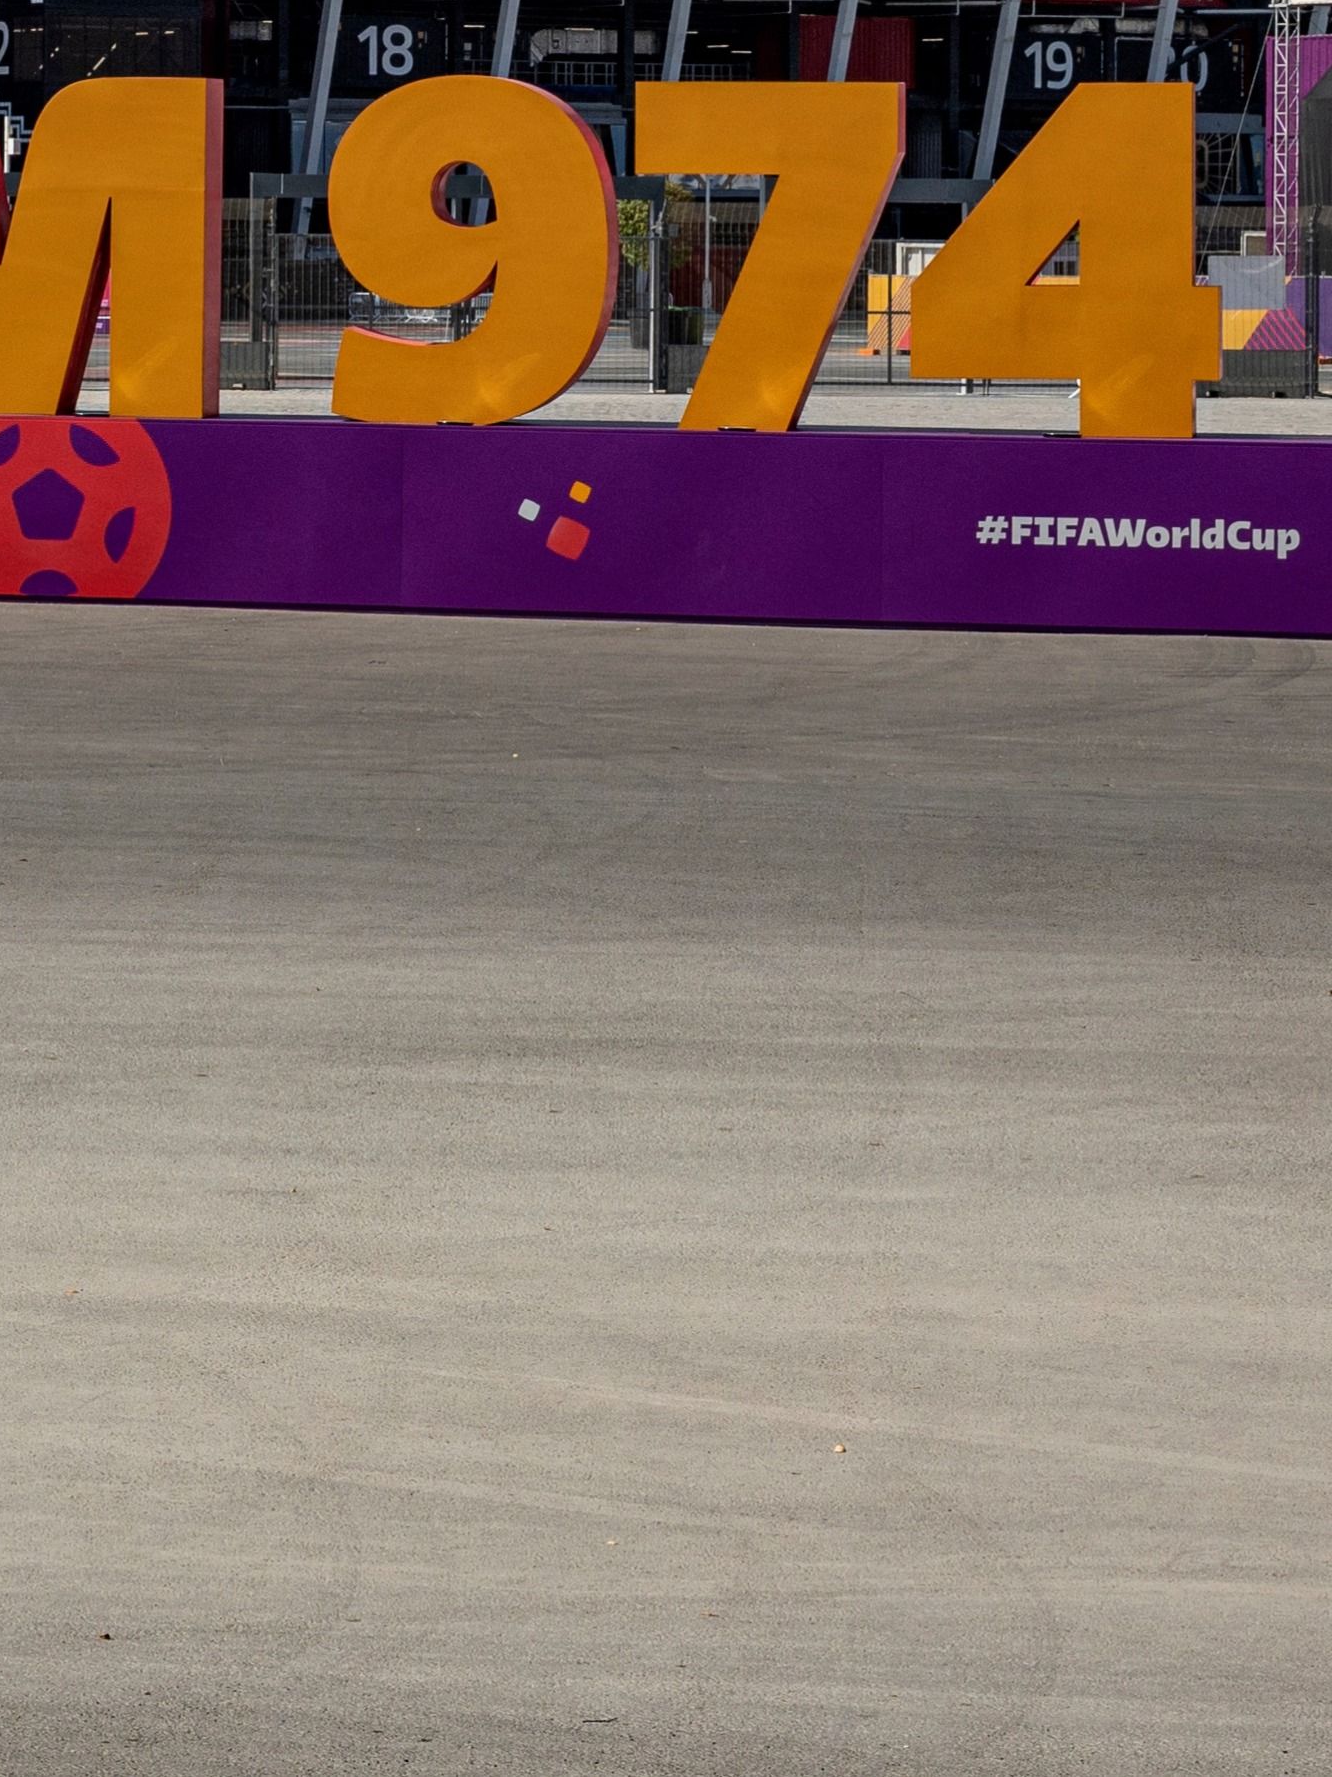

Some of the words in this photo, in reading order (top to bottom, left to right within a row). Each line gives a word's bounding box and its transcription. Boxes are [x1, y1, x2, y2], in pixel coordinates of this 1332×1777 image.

[357, 24, 414, 76] 18
[1023, 41, 1074, 90] 19
[328, 74, 1224, 439] 974
[975, 514, 1301, 560] #FIFAWorldCup
